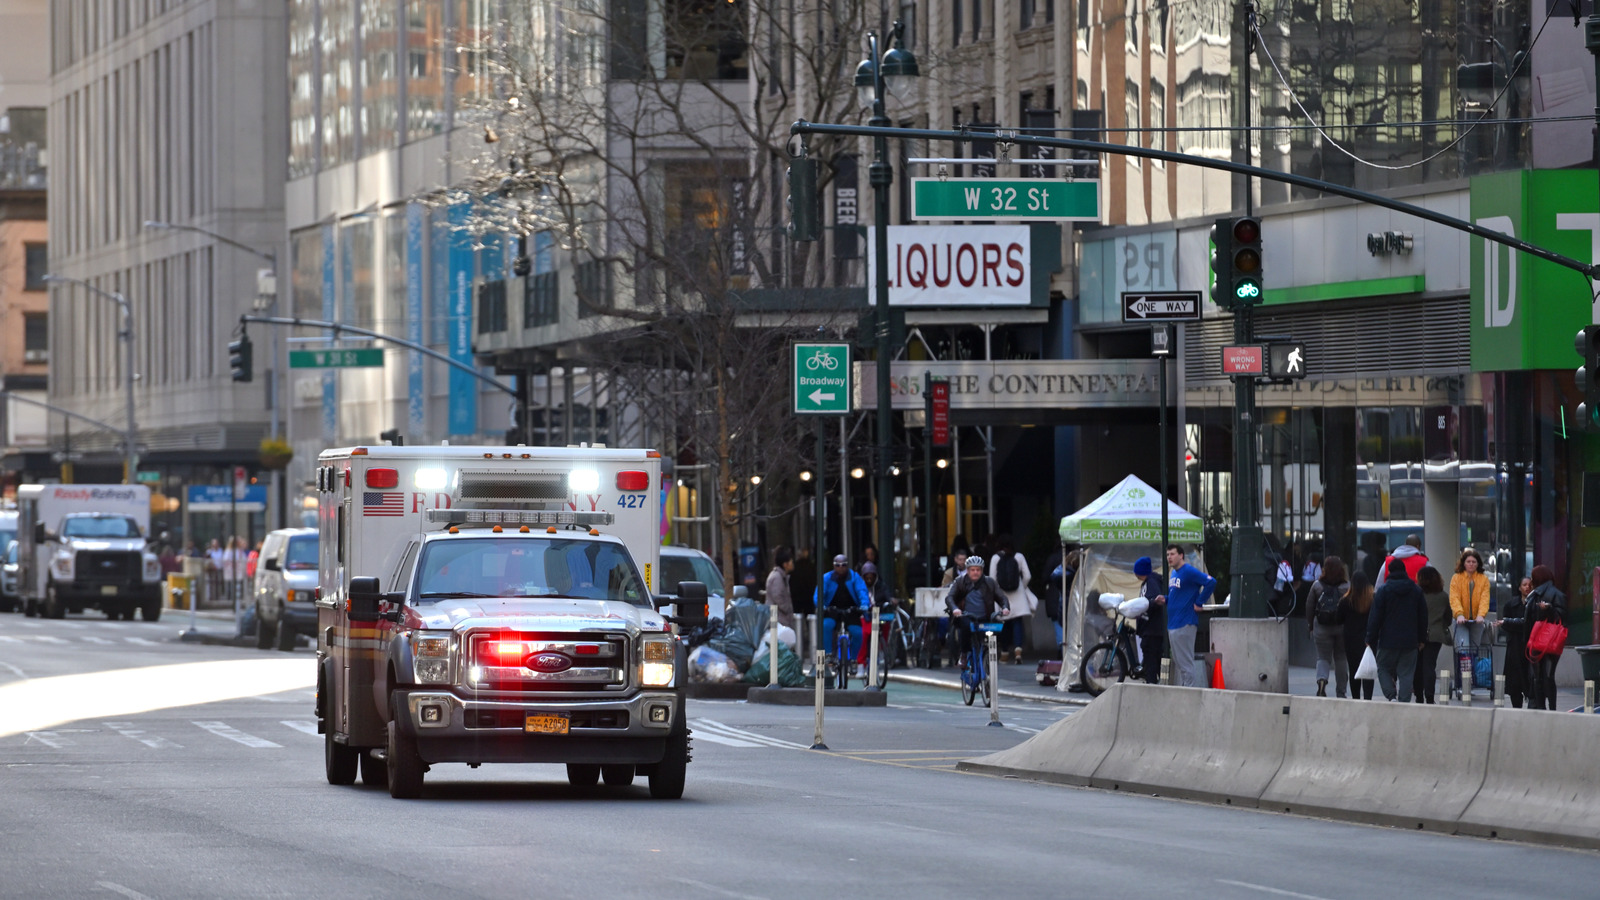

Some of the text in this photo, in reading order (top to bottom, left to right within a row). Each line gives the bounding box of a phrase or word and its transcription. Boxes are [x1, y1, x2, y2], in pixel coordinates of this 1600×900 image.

[964, 187, 1050, 211] W 32 St
[836, 188, 857, 225] BEER
[888, 242, 1025, 290] IQUORS
[1136, 301, 1188, 312] ONE WAY
[1230, 356, 1256, 364] WRONG
[1235, 363, 1250, 371] WAY
[799, 376, 845, 387] Broadway
[931, 374, 980, 395] HE
[617, 494, 647, 509] 427
[1100, 519, 1185, 528] COVID-19 TESING
[1082, 530, 1202, 540] PCR & RAPID ATIGEN
[536, 656, 562, 667] Ford
